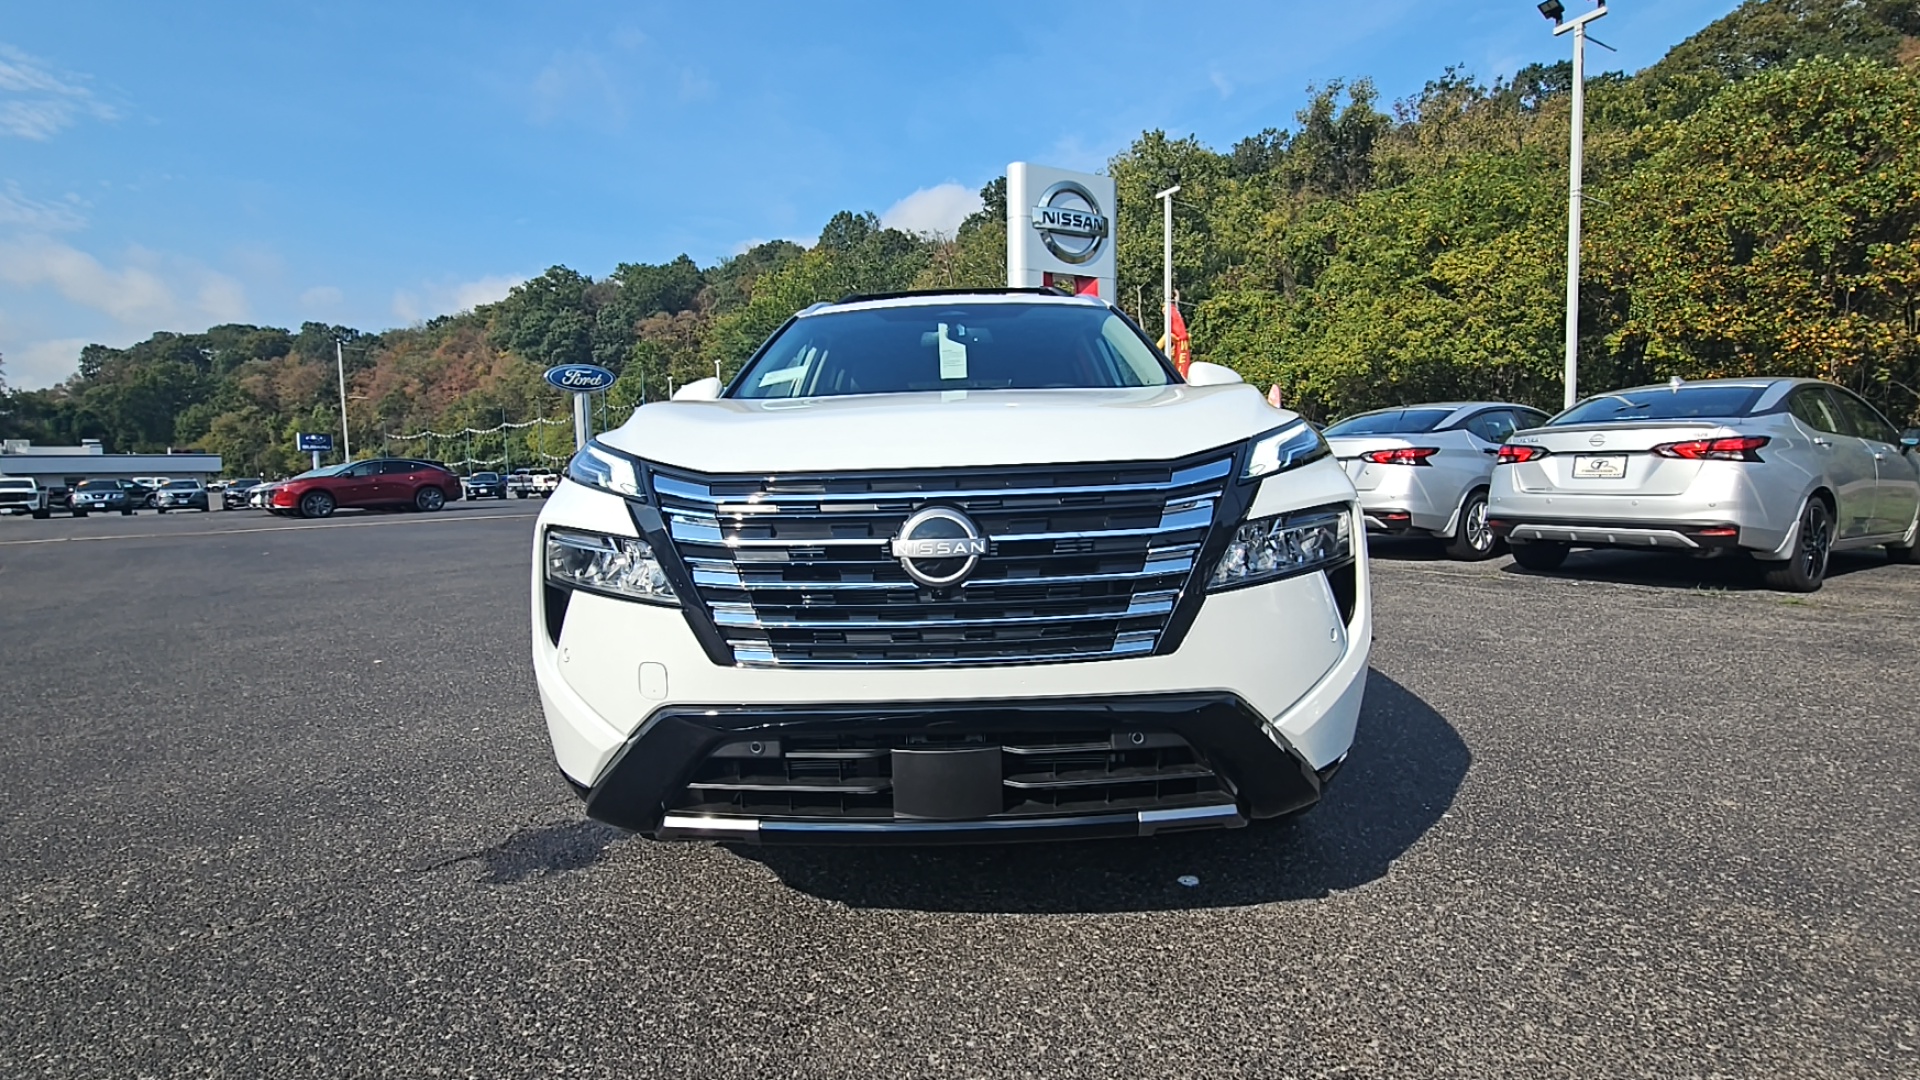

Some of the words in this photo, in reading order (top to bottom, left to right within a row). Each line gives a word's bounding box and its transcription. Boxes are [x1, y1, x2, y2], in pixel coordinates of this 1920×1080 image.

[1042, 210, 1103, 231] NISSAN
[561, 369, 603, 386] Ford
[895, 540, 985, 555] NISSAN
